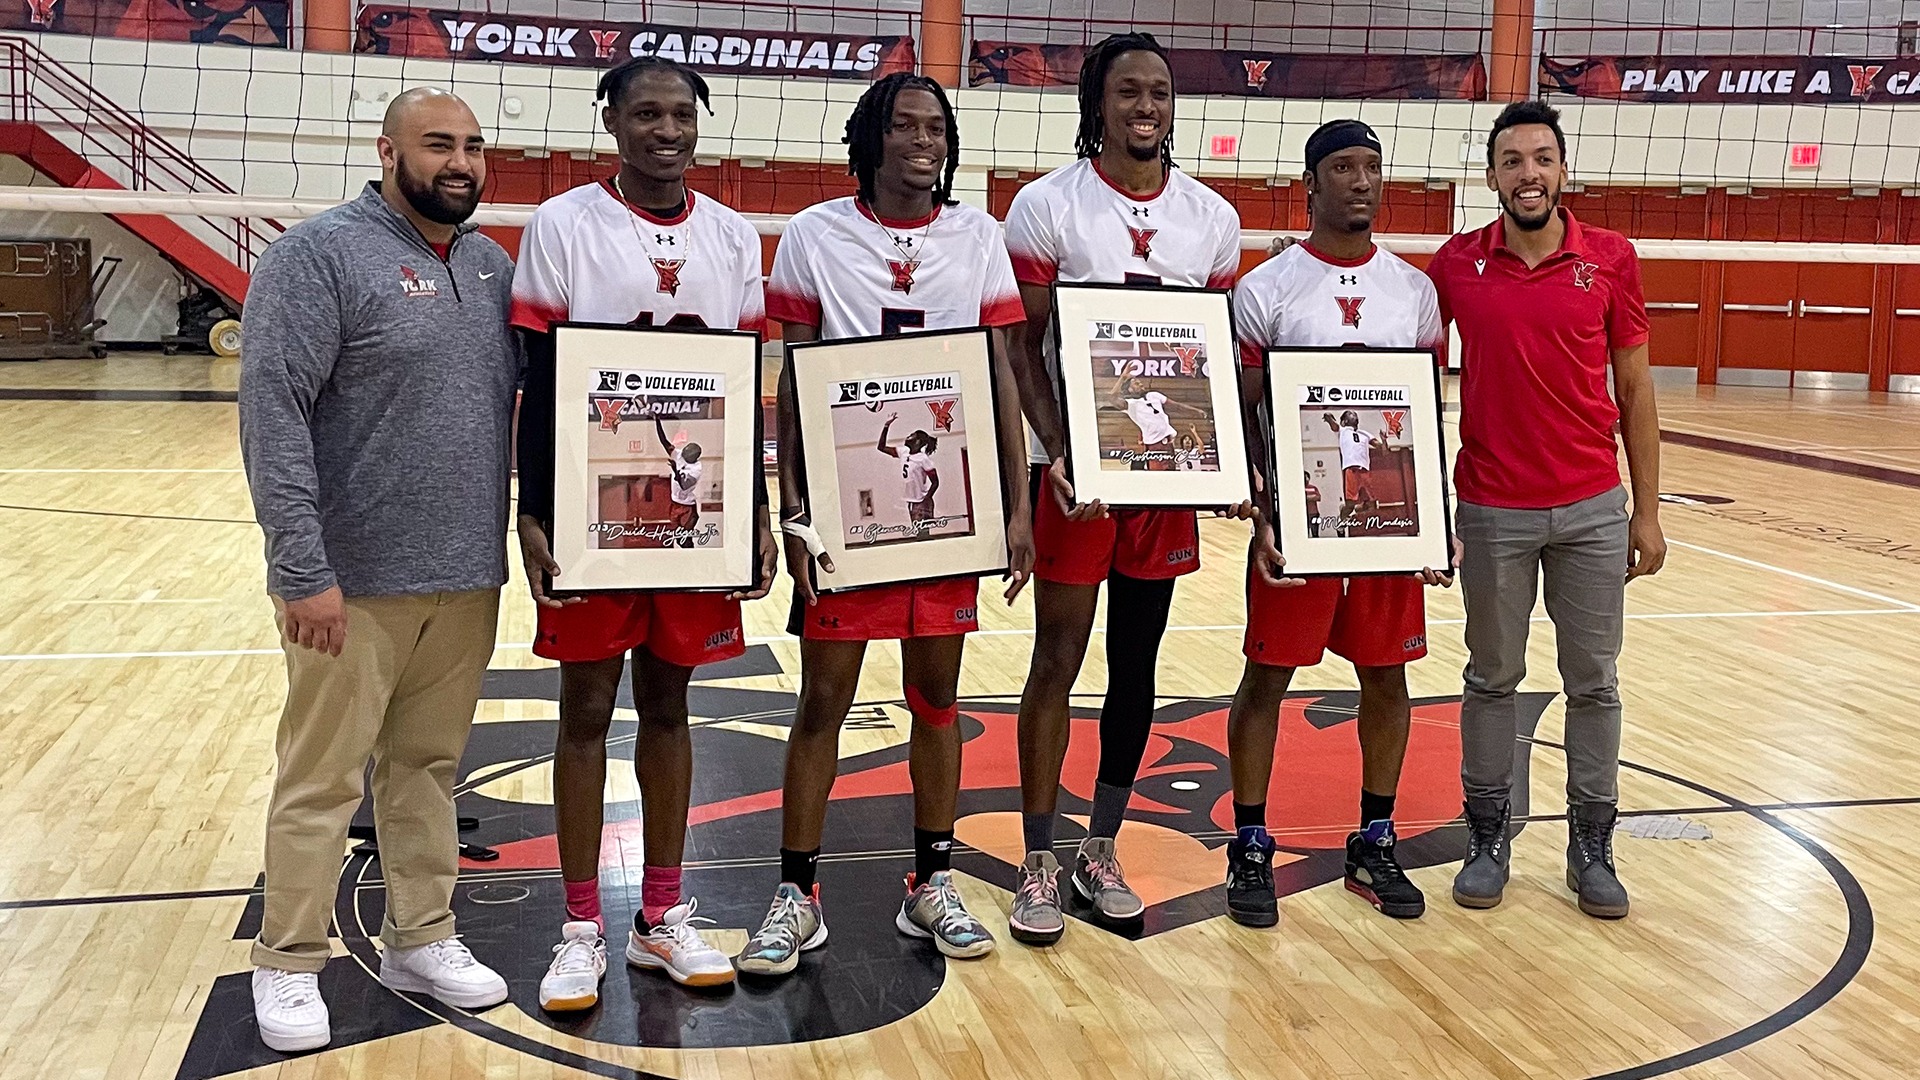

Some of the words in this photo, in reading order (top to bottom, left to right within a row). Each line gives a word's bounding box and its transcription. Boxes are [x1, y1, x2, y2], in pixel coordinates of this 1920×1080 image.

[442, 19, 581, 58] YORK
[628, 31, 884, 73] CARDINALS
[1621, 69, 1710, 94] PLAY
[1717, 69, 1797, 94] LIKE
[1804, 70, 1832, 95] A
[1211, 136, 1237, 155] EXIT
[1792, 145, 1819, 165] EXIT
[1135, 326, 1197, 339] VOLLEYBALL
[1111, 359, 1177, 376] YORK
[645, 376, 716, 391] VOLLEYBALL
[884, 376, 953, 395] VOLLEYBALL
[1344, 389, 1404, 401] VOLLEYBALL
[607, 525, 646, 540] David
[956, 608, 977, 619] CU
